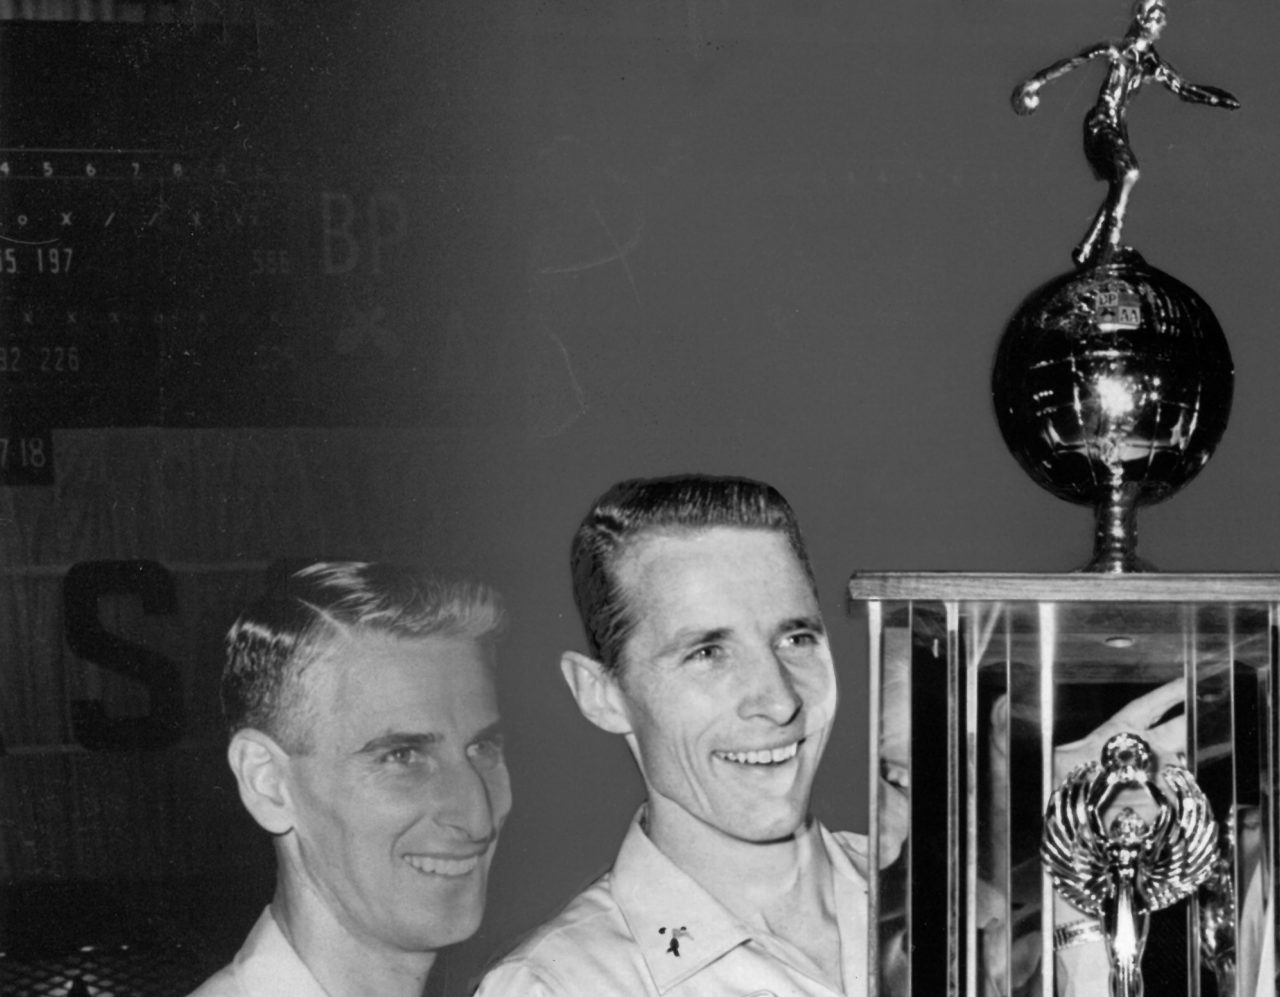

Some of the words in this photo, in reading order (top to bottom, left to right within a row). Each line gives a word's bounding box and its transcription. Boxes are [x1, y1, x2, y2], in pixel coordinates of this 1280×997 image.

[36, 247, 74, 274] 197
[41, 346, 79, 371] 226
[62, 558, 182, 751] S
